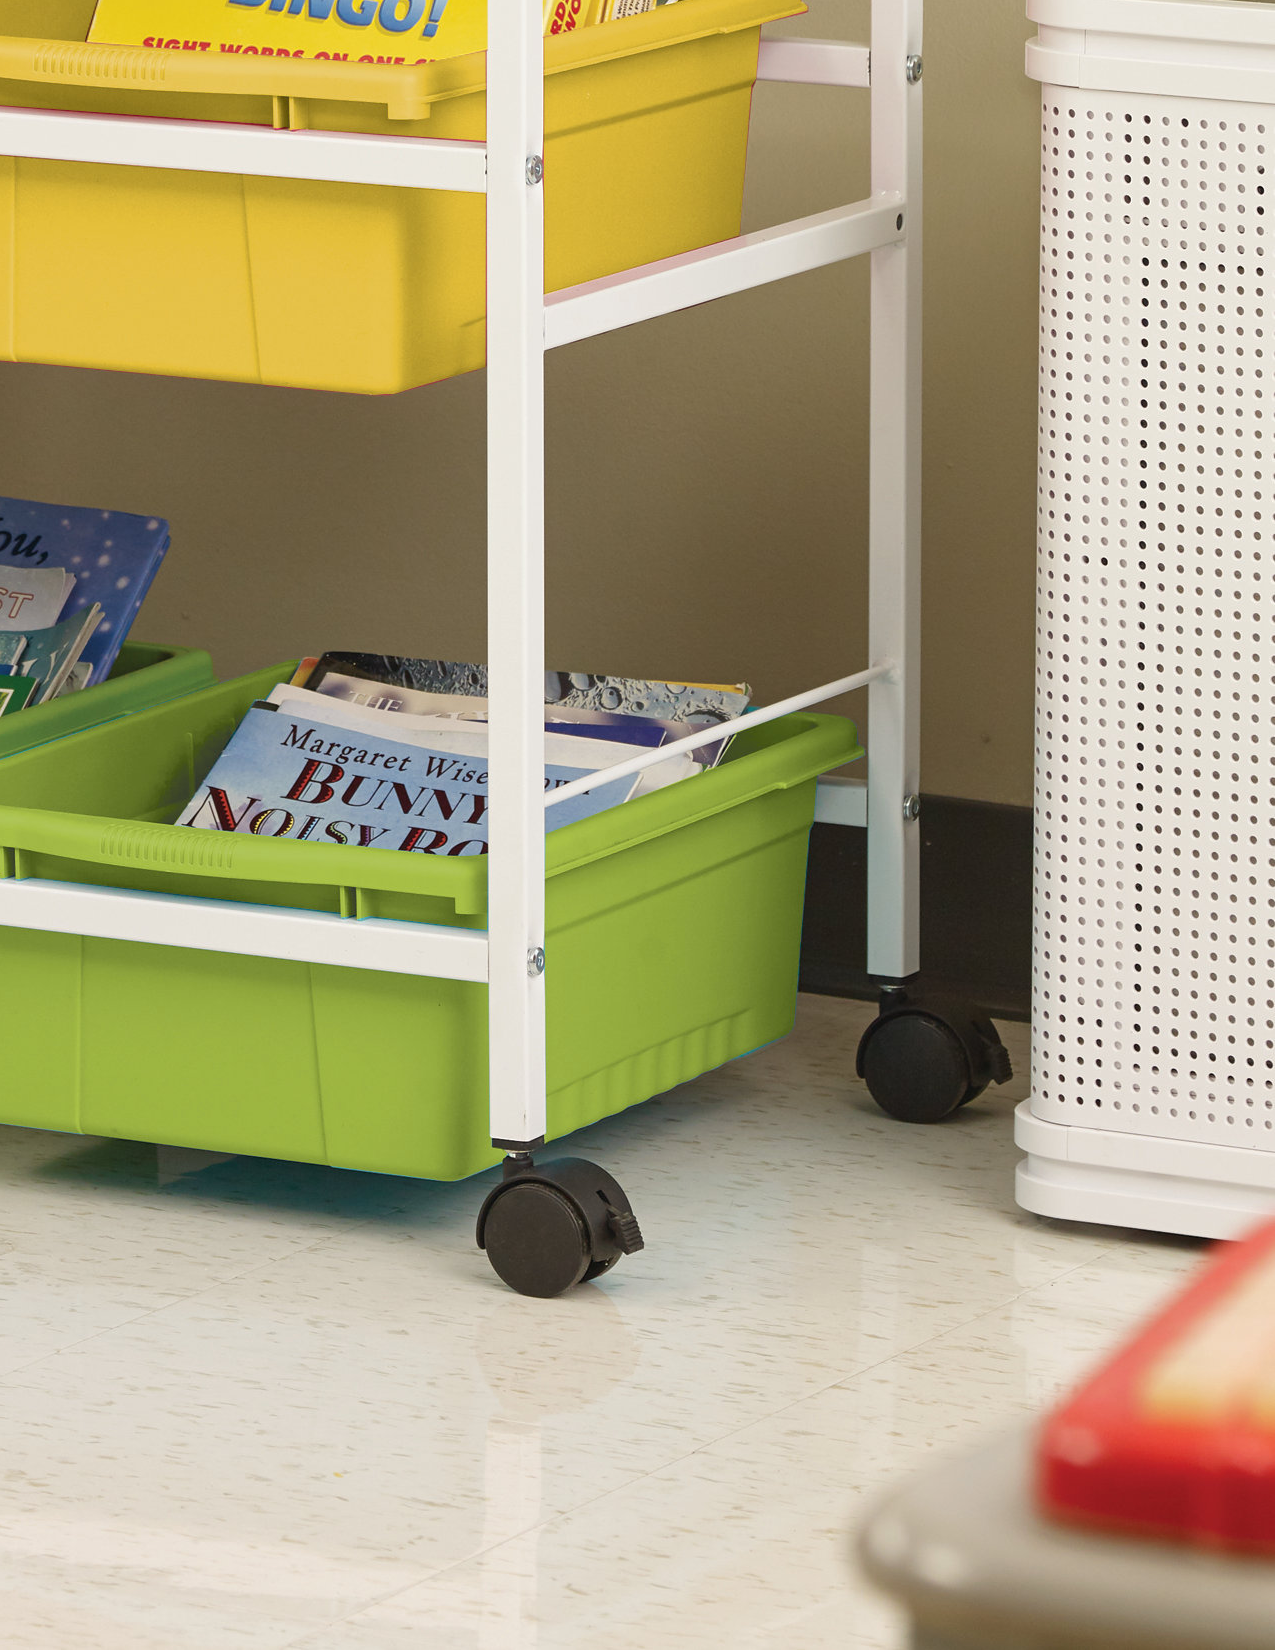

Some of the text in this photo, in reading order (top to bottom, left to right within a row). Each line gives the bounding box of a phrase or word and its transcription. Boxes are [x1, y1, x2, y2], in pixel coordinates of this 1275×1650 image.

[281, 724, 488, 784] Margaret Wise
[182, 785, 391, 846] NOISY
